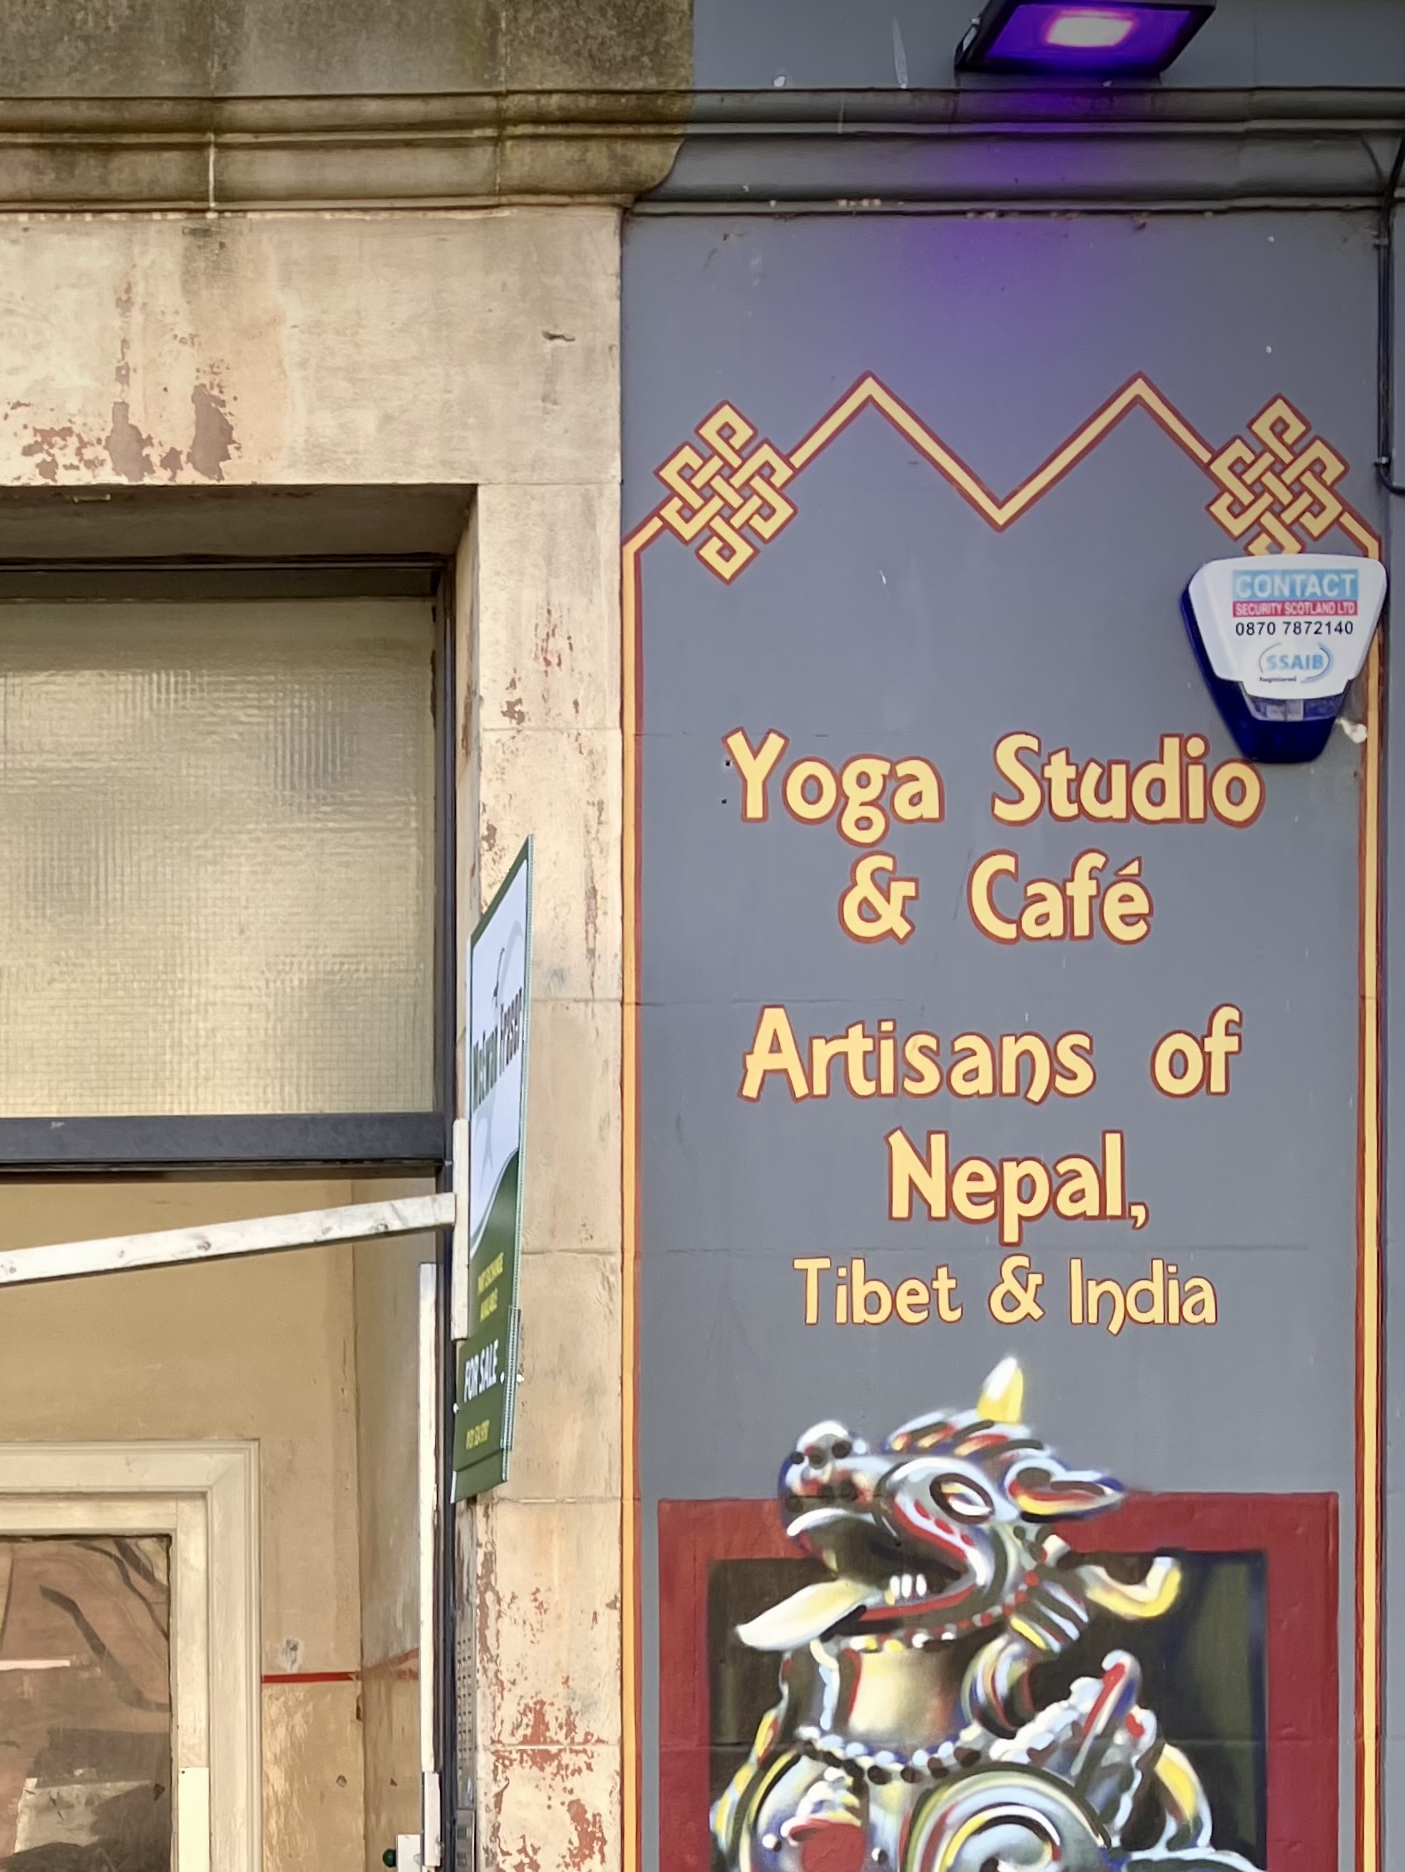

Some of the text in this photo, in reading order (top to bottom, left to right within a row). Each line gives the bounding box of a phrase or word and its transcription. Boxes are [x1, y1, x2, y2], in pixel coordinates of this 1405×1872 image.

[1235, 602, 1355, 616] SECURITY SCOTLAND LTD
[1236, 573, 1356, 598] CONTACT
[1235, 620, 1354, 636] 0870 7872140
[1266, 654, 1324, 670] SSAIB
[722, 727, 1265, 847] Yoga Studio
[839, 849, 1153, 945] & Café
[739, 1003, 1243, 1105] Artisans of
[884, 1126, 1149, 1246] Nepal,
[793, 1254, 1218, 1336] Tibet & India
[463, 1339, 500, 1403] FOR SALE
